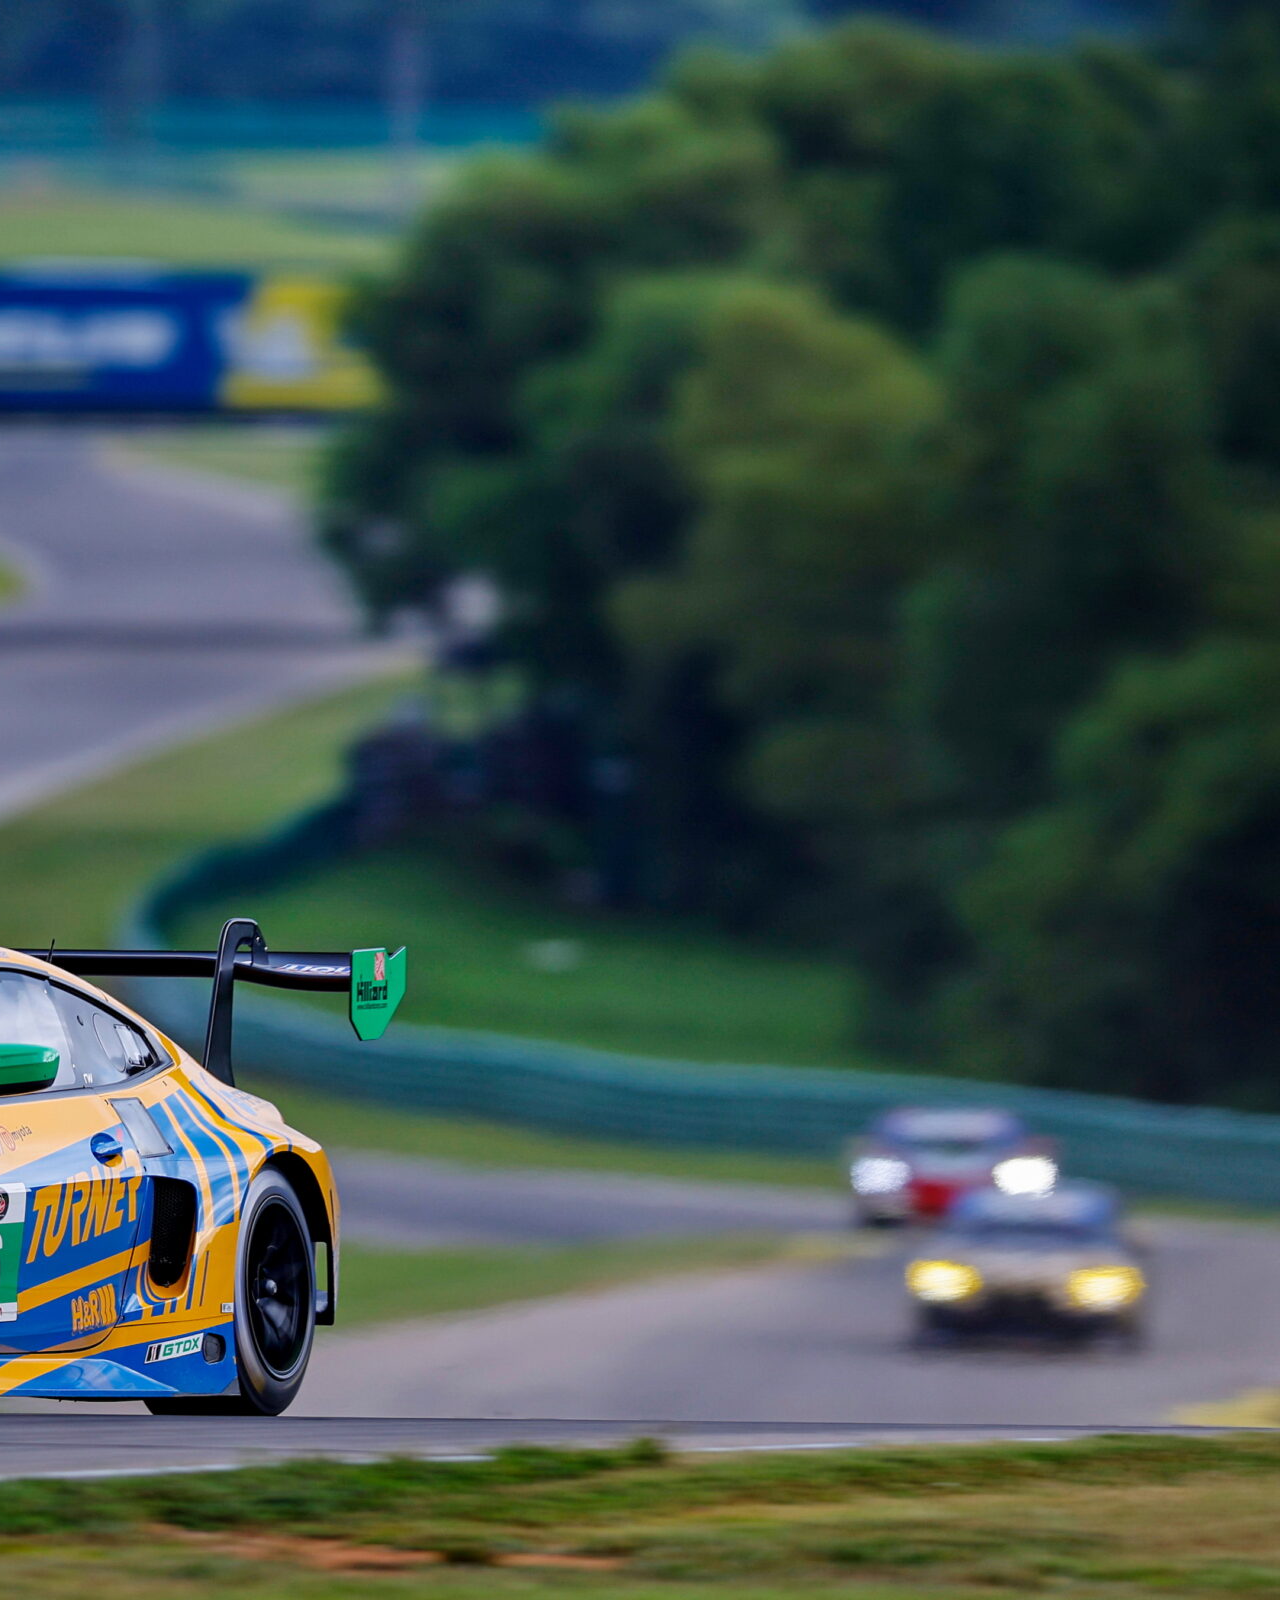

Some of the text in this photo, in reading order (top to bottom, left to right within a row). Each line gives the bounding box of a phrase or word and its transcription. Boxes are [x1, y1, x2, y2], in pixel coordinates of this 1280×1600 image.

[26, 1149, 143, 1264] TURNER
[71, 1289, 102, 1333] H&R
[162, 1337, 200, 1357] GTDX
